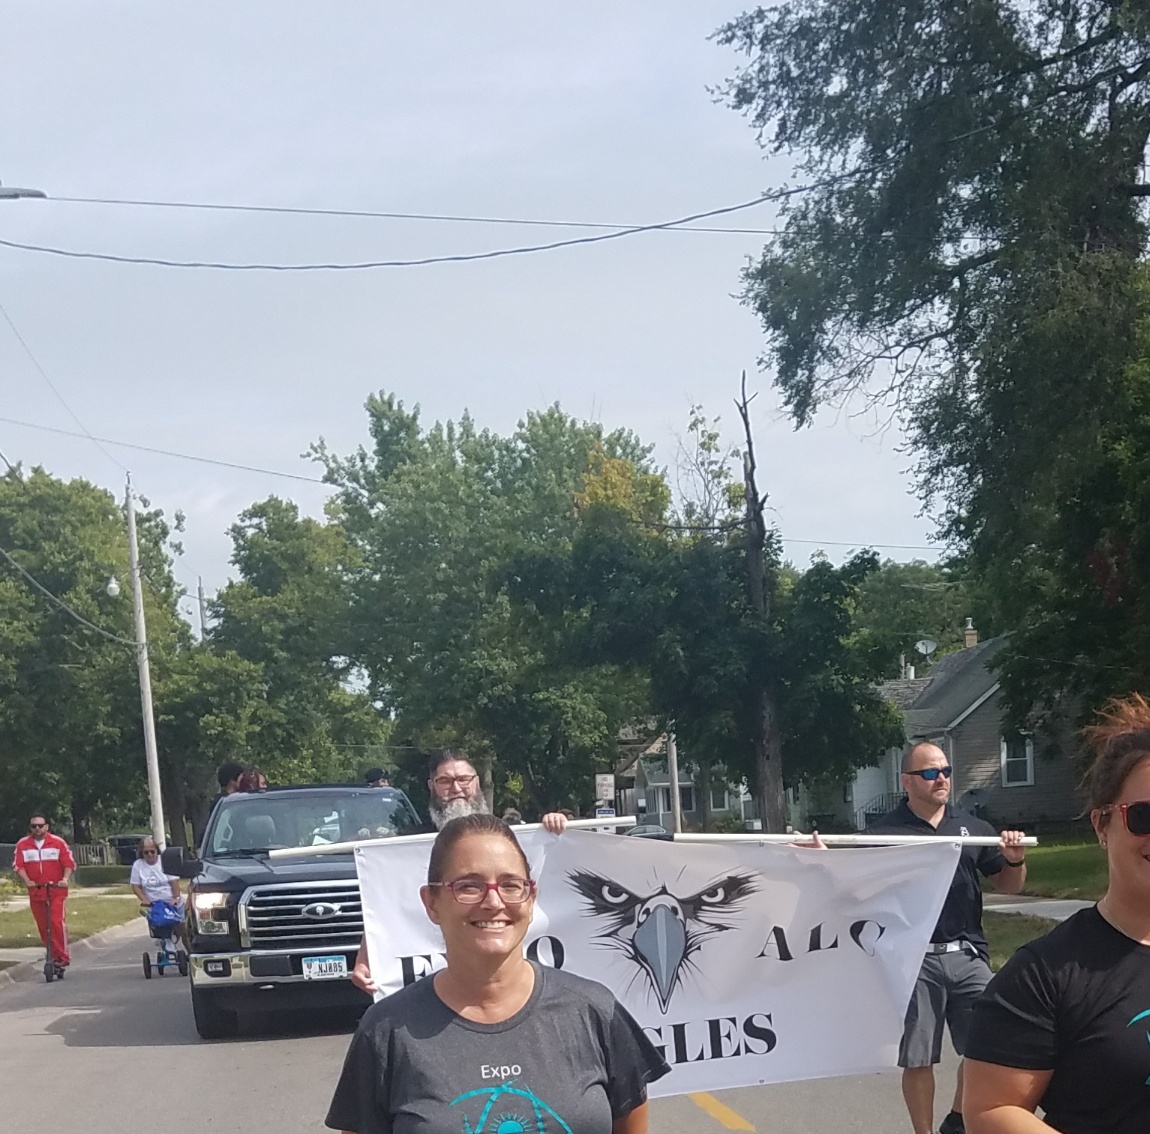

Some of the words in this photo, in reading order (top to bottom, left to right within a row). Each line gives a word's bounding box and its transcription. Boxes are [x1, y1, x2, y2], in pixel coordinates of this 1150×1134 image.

[395, 935, 565, 988] EO
[755, 919, 886, 962] ALC
[641, 1012, 777, 1065] GLES
[480, 1064, 522, 1079] Expo
